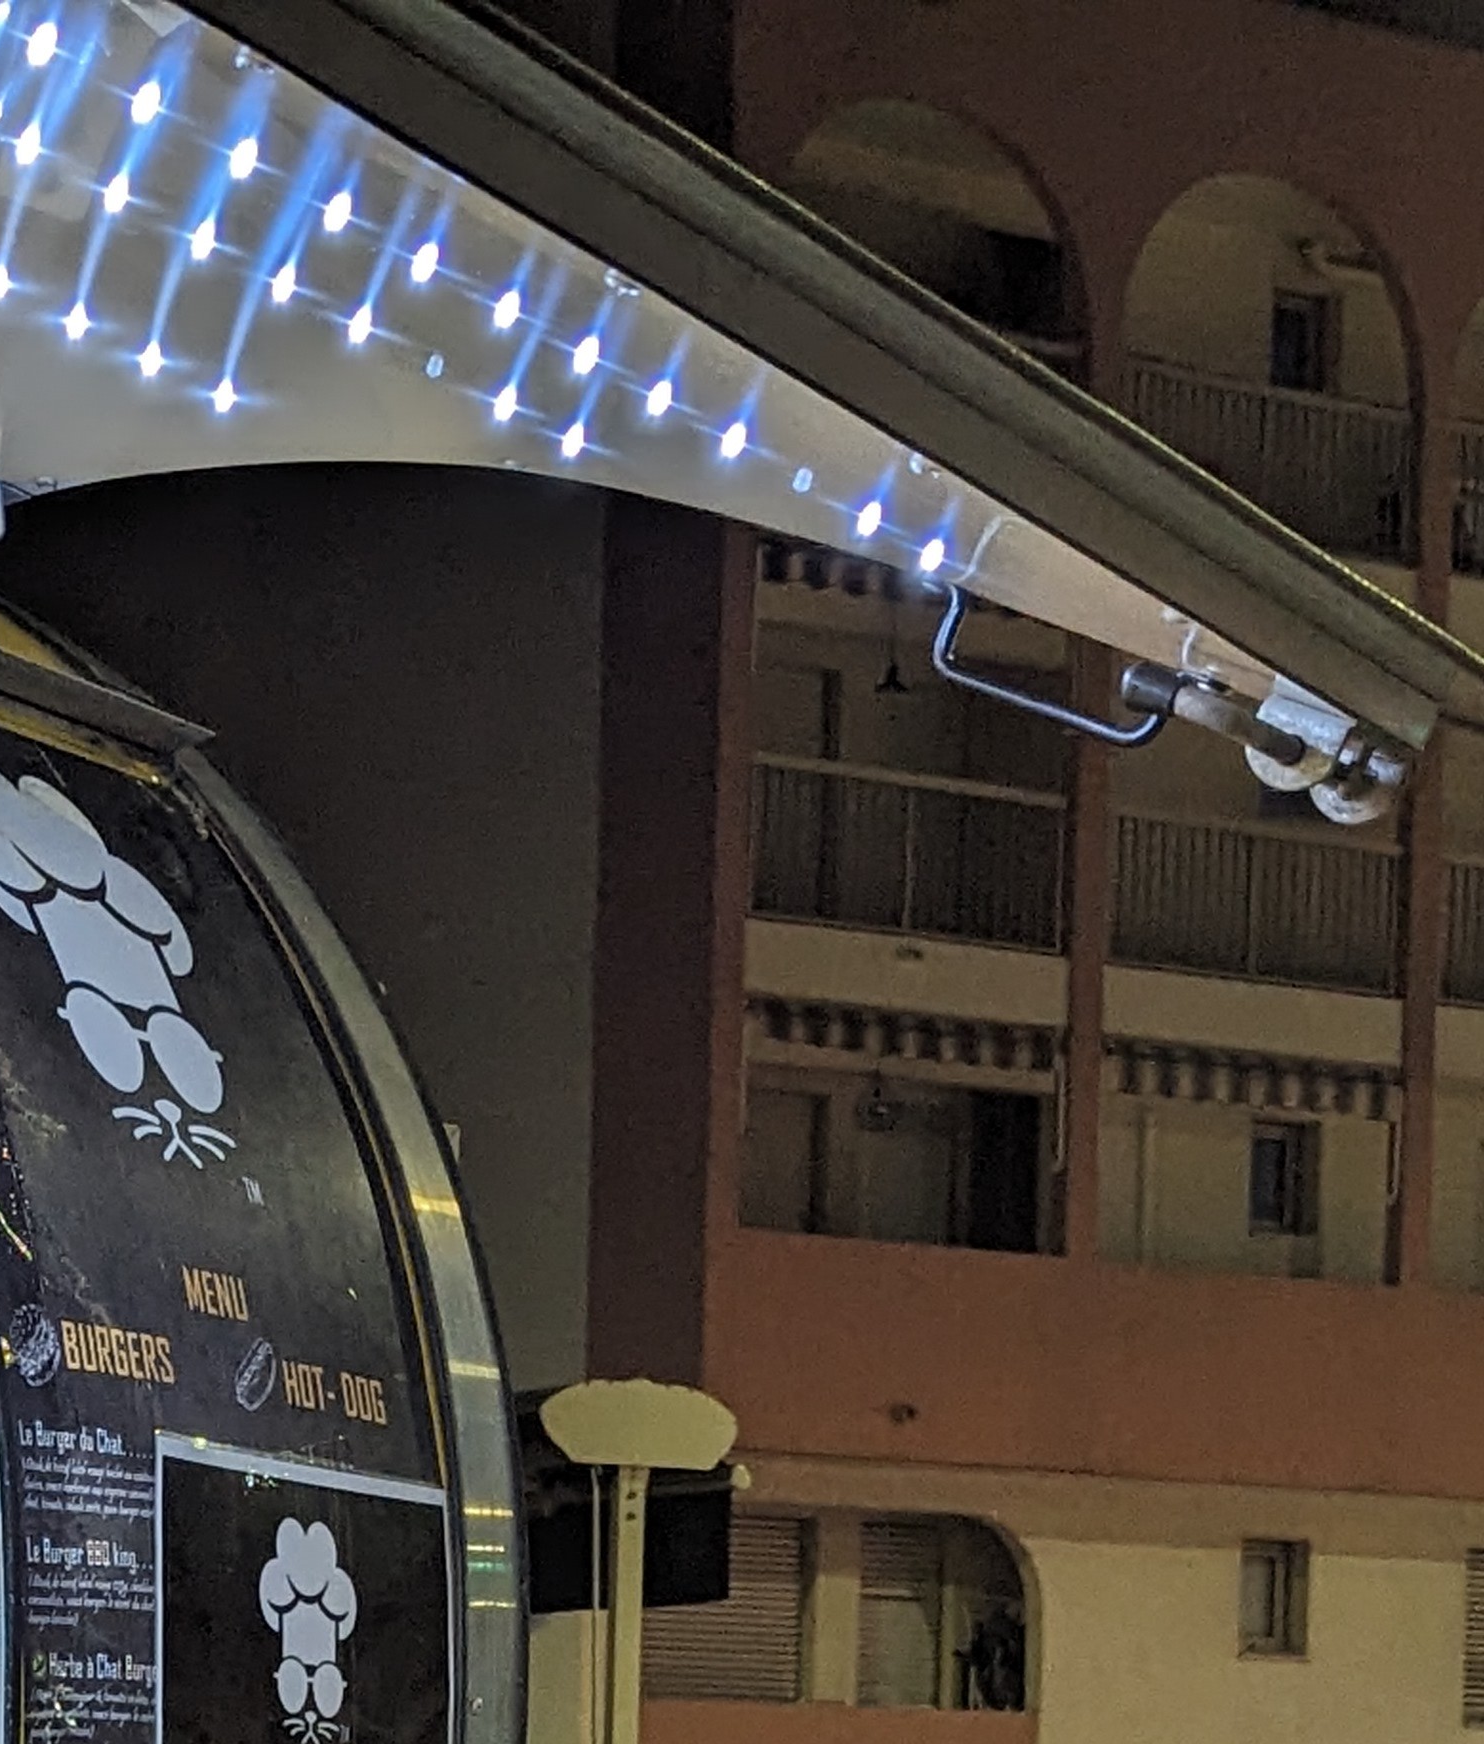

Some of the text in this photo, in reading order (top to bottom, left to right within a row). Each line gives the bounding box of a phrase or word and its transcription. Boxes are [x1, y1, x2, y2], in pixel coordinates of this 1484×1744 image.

[182, 1265, 249, 1323] MENU
[60, 1319, 176, 1384] BURGERS
[18, 1419, 33, 1447] Le
[35, 1420, 77, 1455] Burger
[26, 1536, 40, 1563] Le
[43, 1538, 84, 1571] Burger
[96, 1653, 122, 1680] Chat
[125, 1654, 158, 1689] Burge
